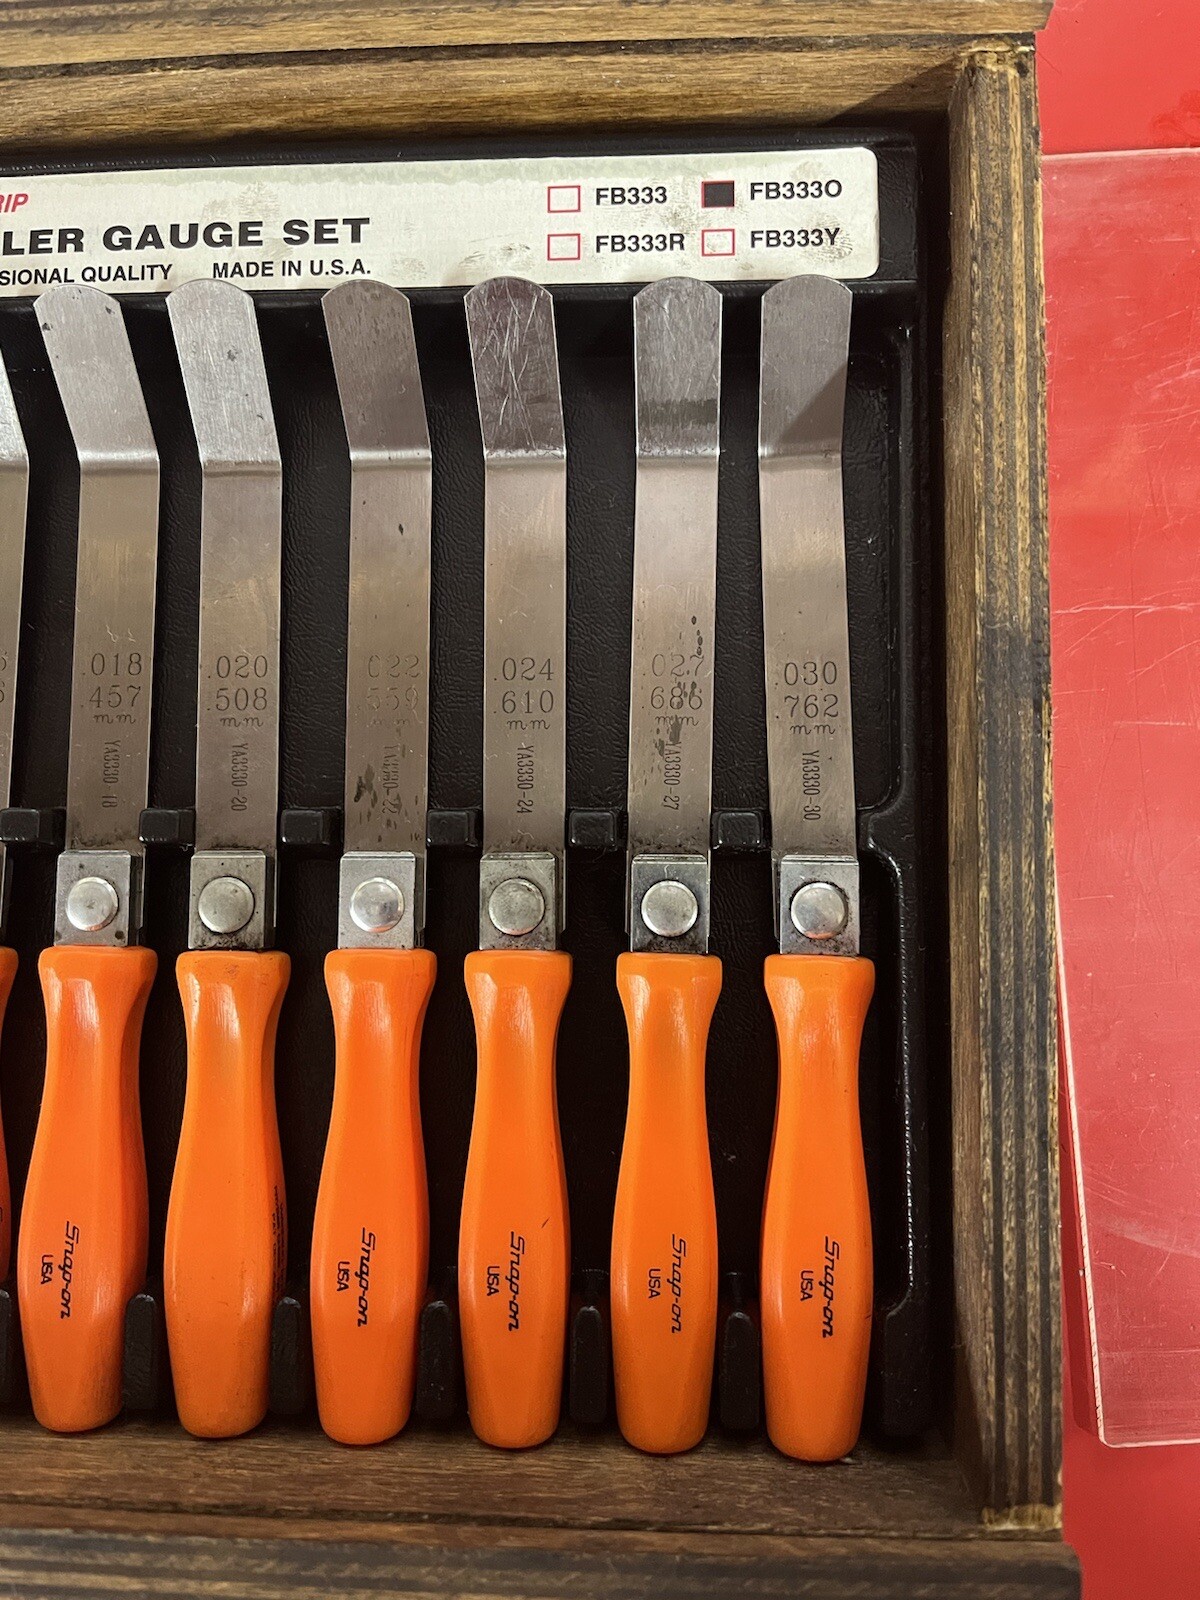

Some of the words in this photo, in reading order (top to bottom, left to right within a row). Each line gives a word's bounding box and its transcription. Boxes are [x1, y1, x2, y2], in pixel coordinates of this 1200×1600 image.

[596, 186, 668, 206] FB333
[2, 228, 84, 256] LER
[102, 221, 264, 251] GAUGE
[283, 217, 370, 246] SET
[596, 233, 685, 253] FB333R
[750, 227, 841, 249] FB333Y
[81, 263, 173, 284] QUALITY
[212, 261, 274, 279] MADE
[281, 260, 302, 277] IN
[309, 258, 372, 276] U.S.A.
[82, 653, 142, 676] .018
[207, 655, 268, 679] .020
[493, 657, 554, 682] .024
[80, 684, 142, 709] .457
[206, 687, 268, 712] .508
[493, 689, 554, 714] .610
[231, 743, 249, 812] YA3330-20
[516, 745, 534, 814] YA3330-24
[801, 750, 821, 821] YA3330-30
[40, 1254, 54, 1285] USA
[58, 1220, 80, 1319] Snap-on
[336, 1261, 350, 1292] USA
[354, 1227, 376, 1327] Snap-on
[486, 1265, 500, 1297] USA
[505, 1231, 525, 1332] Snap-on
[648, 1268, 661, 1299] USA
[666, 1233, 687, 1334] Snap-on
[800, 1270, 814, 1301] USA
[818, 1235, 840, 1338] Snap-on
